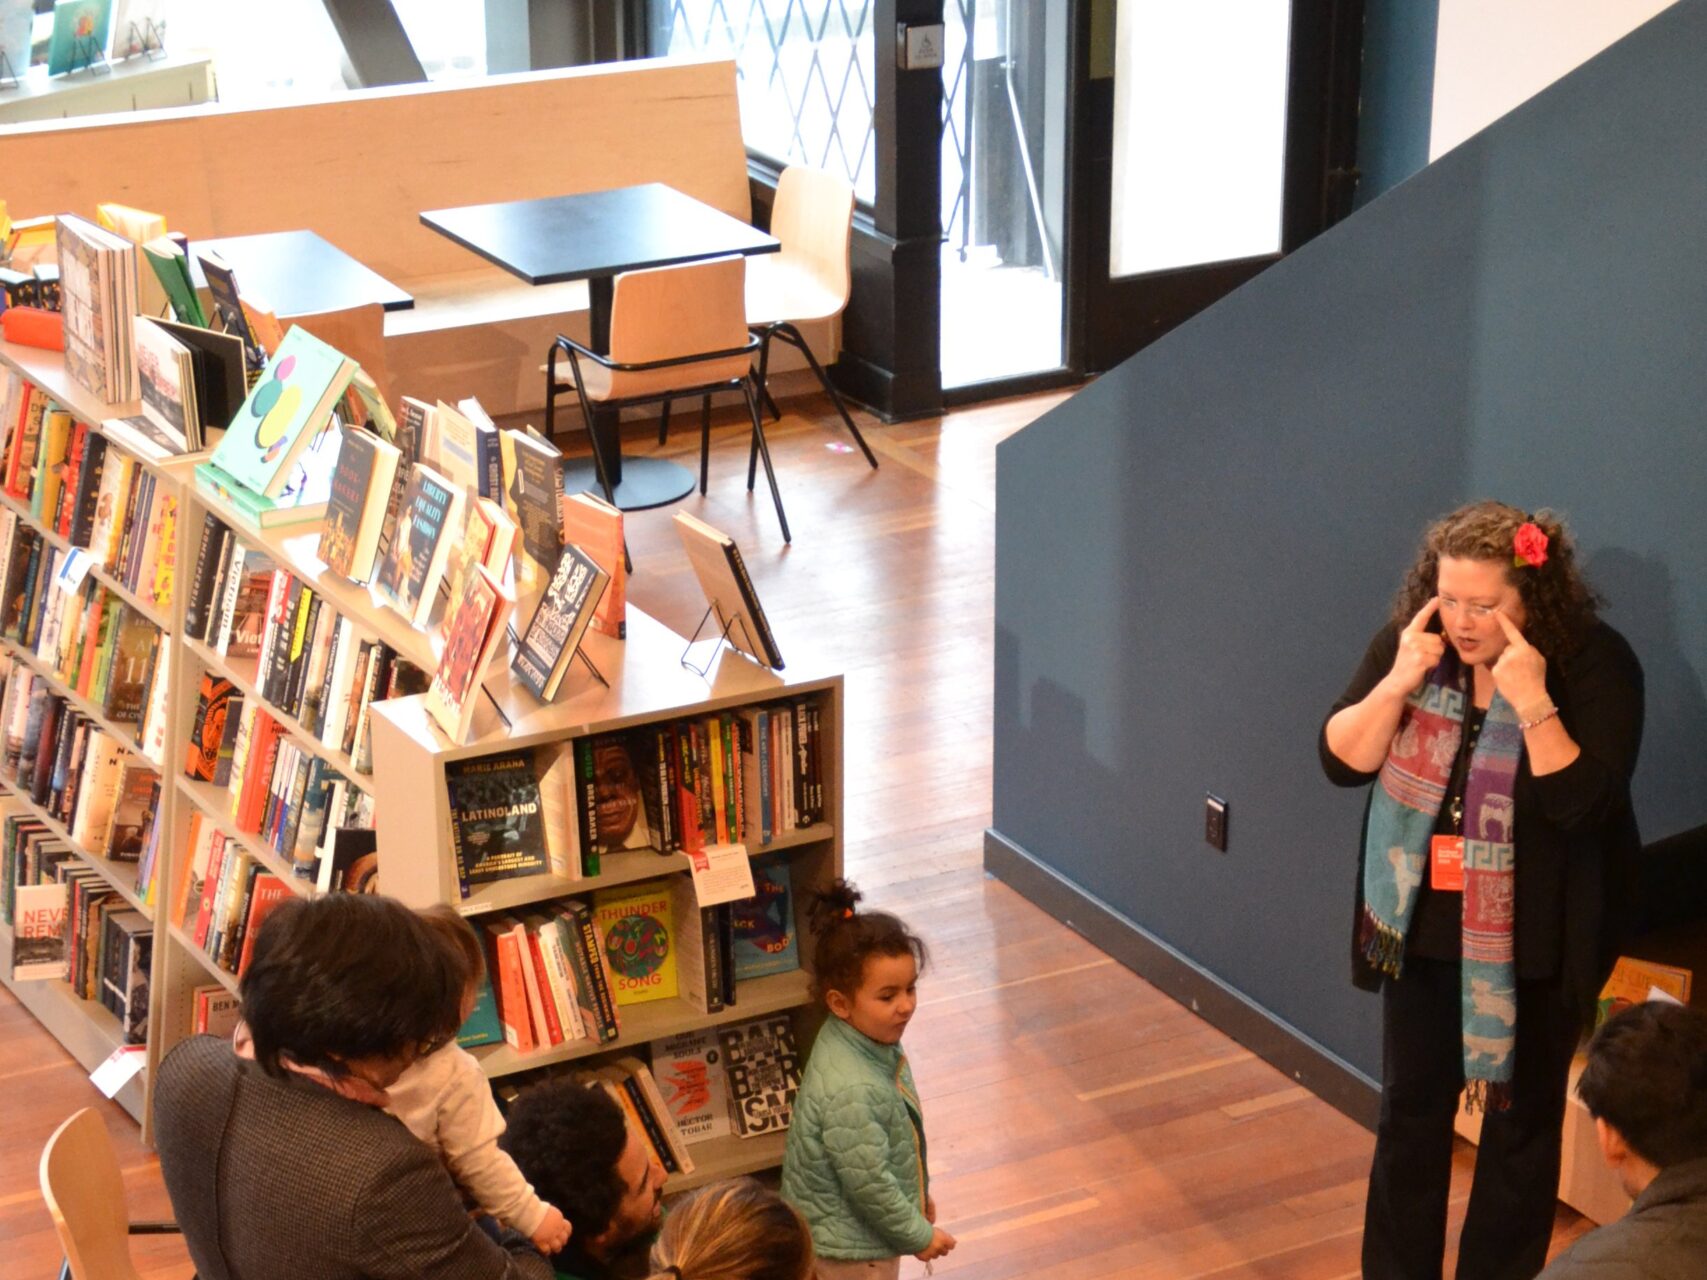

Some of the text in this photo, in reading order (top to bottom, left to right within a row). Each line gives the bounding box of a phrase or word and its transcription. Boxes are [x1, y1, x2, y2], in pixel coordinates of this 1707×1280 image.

[462, 802, 537, 822] LATINOLAND
[601, 900, 667, 920] THUNDER
[766, 932, 794, 954] BODY
[618, 973, 662, 990] SONG
[212, 1001, 230, 1012] BEN
[680, 1123, 713, 1137] TOBAR
